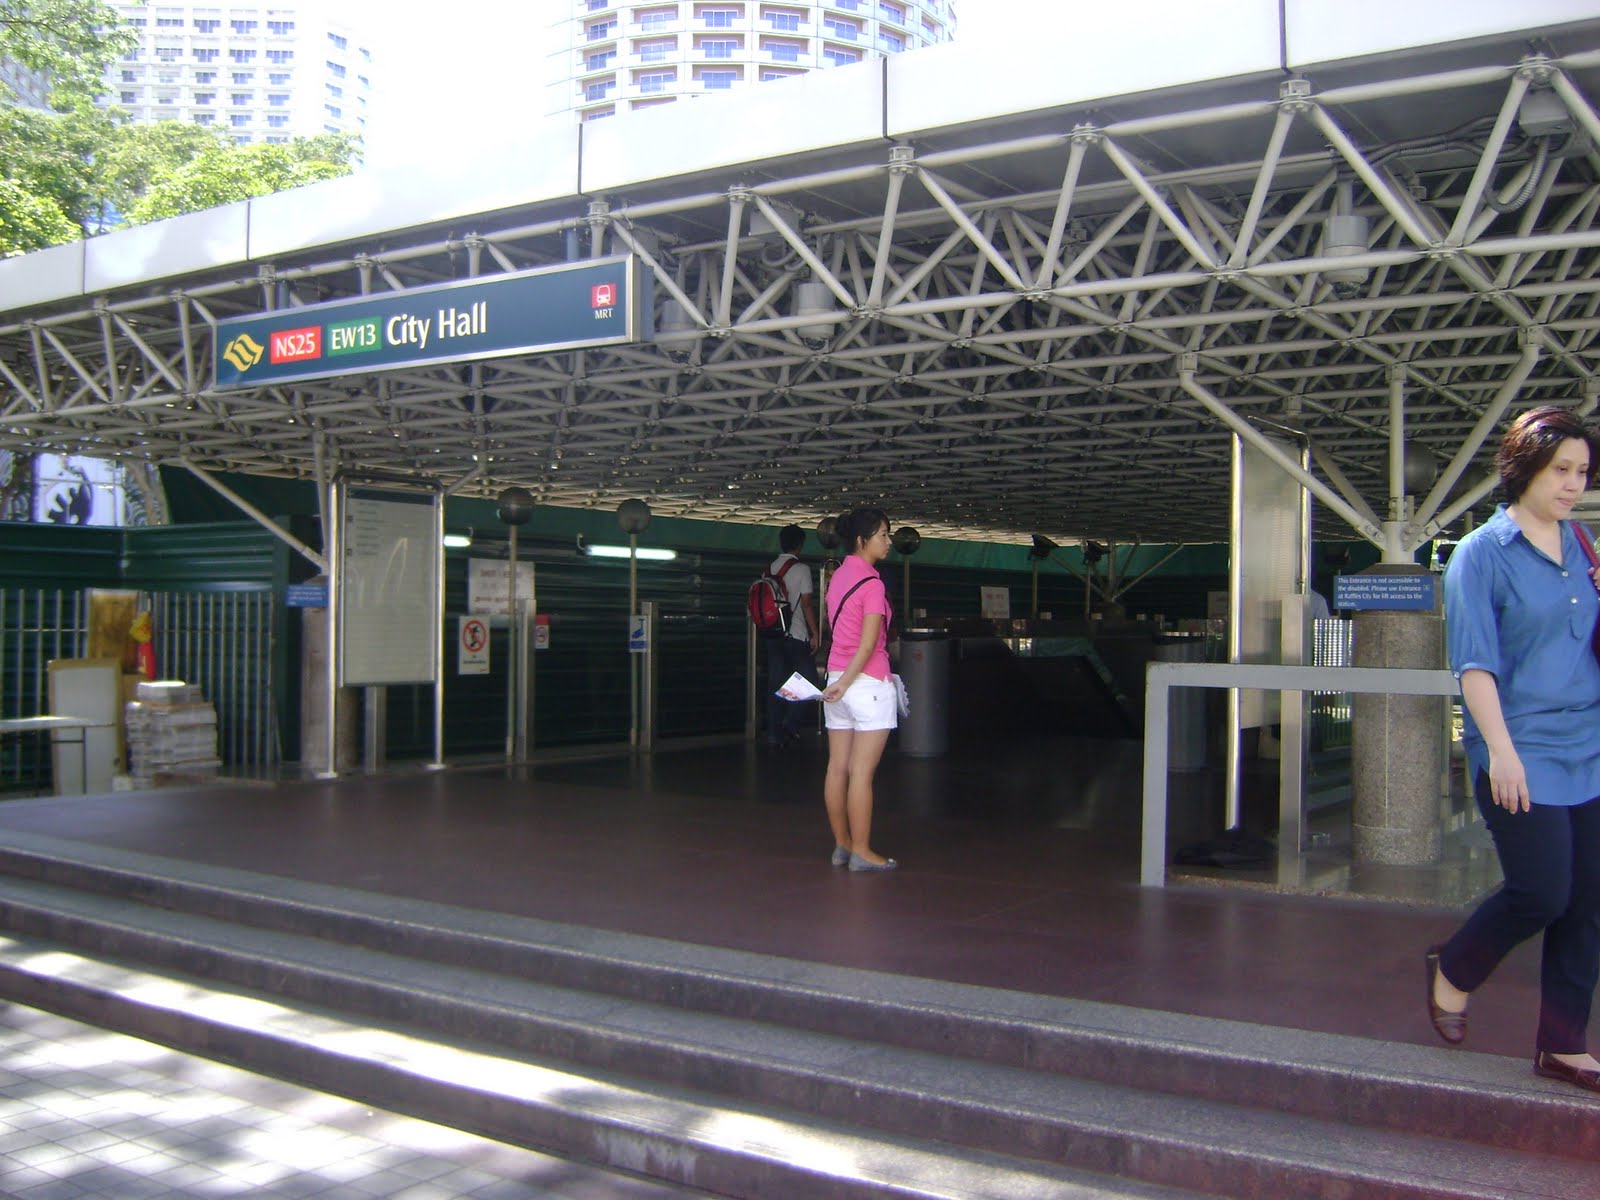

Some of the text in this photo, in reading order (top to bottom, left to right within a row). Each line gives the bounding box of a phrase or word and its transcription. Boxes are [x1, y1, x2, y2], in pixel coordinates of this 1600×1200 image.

[275, 301, 487, 358] NS25 EW13 City Hall
[594, 308, 613, 320] MRT
